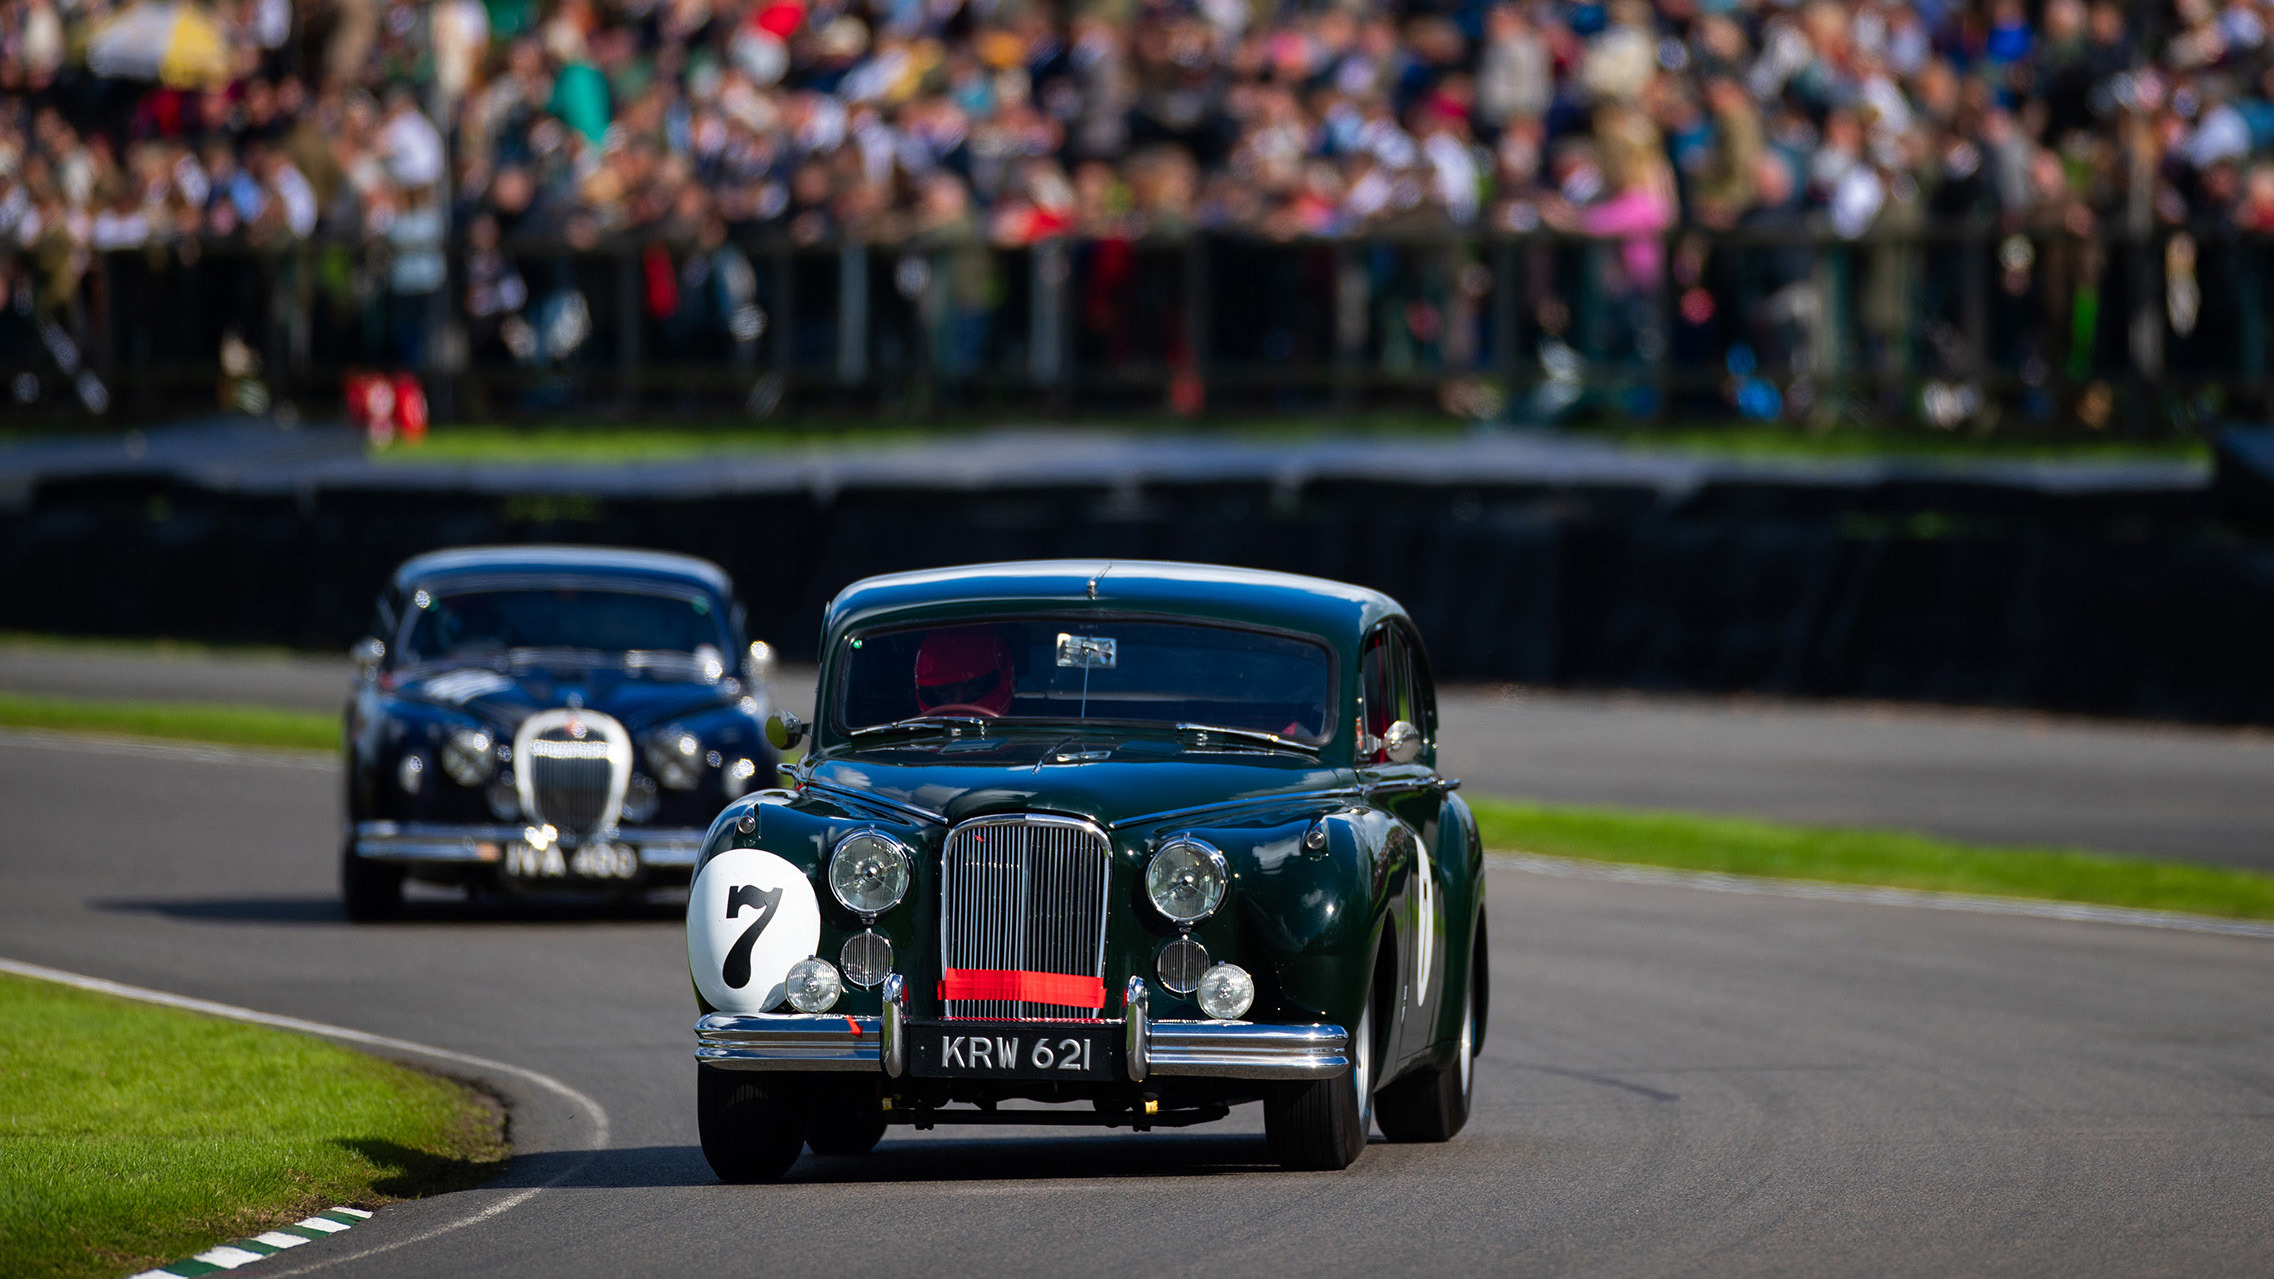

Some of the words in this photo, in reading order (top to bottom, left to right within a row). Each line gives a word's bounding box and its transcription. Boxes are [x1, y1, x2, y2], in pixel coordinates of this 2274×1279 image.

[722, 884, 784, 989] 7
[941, 1036, 1019, 1069] KRW
[1031, 1038, 1091, 1071] 621
